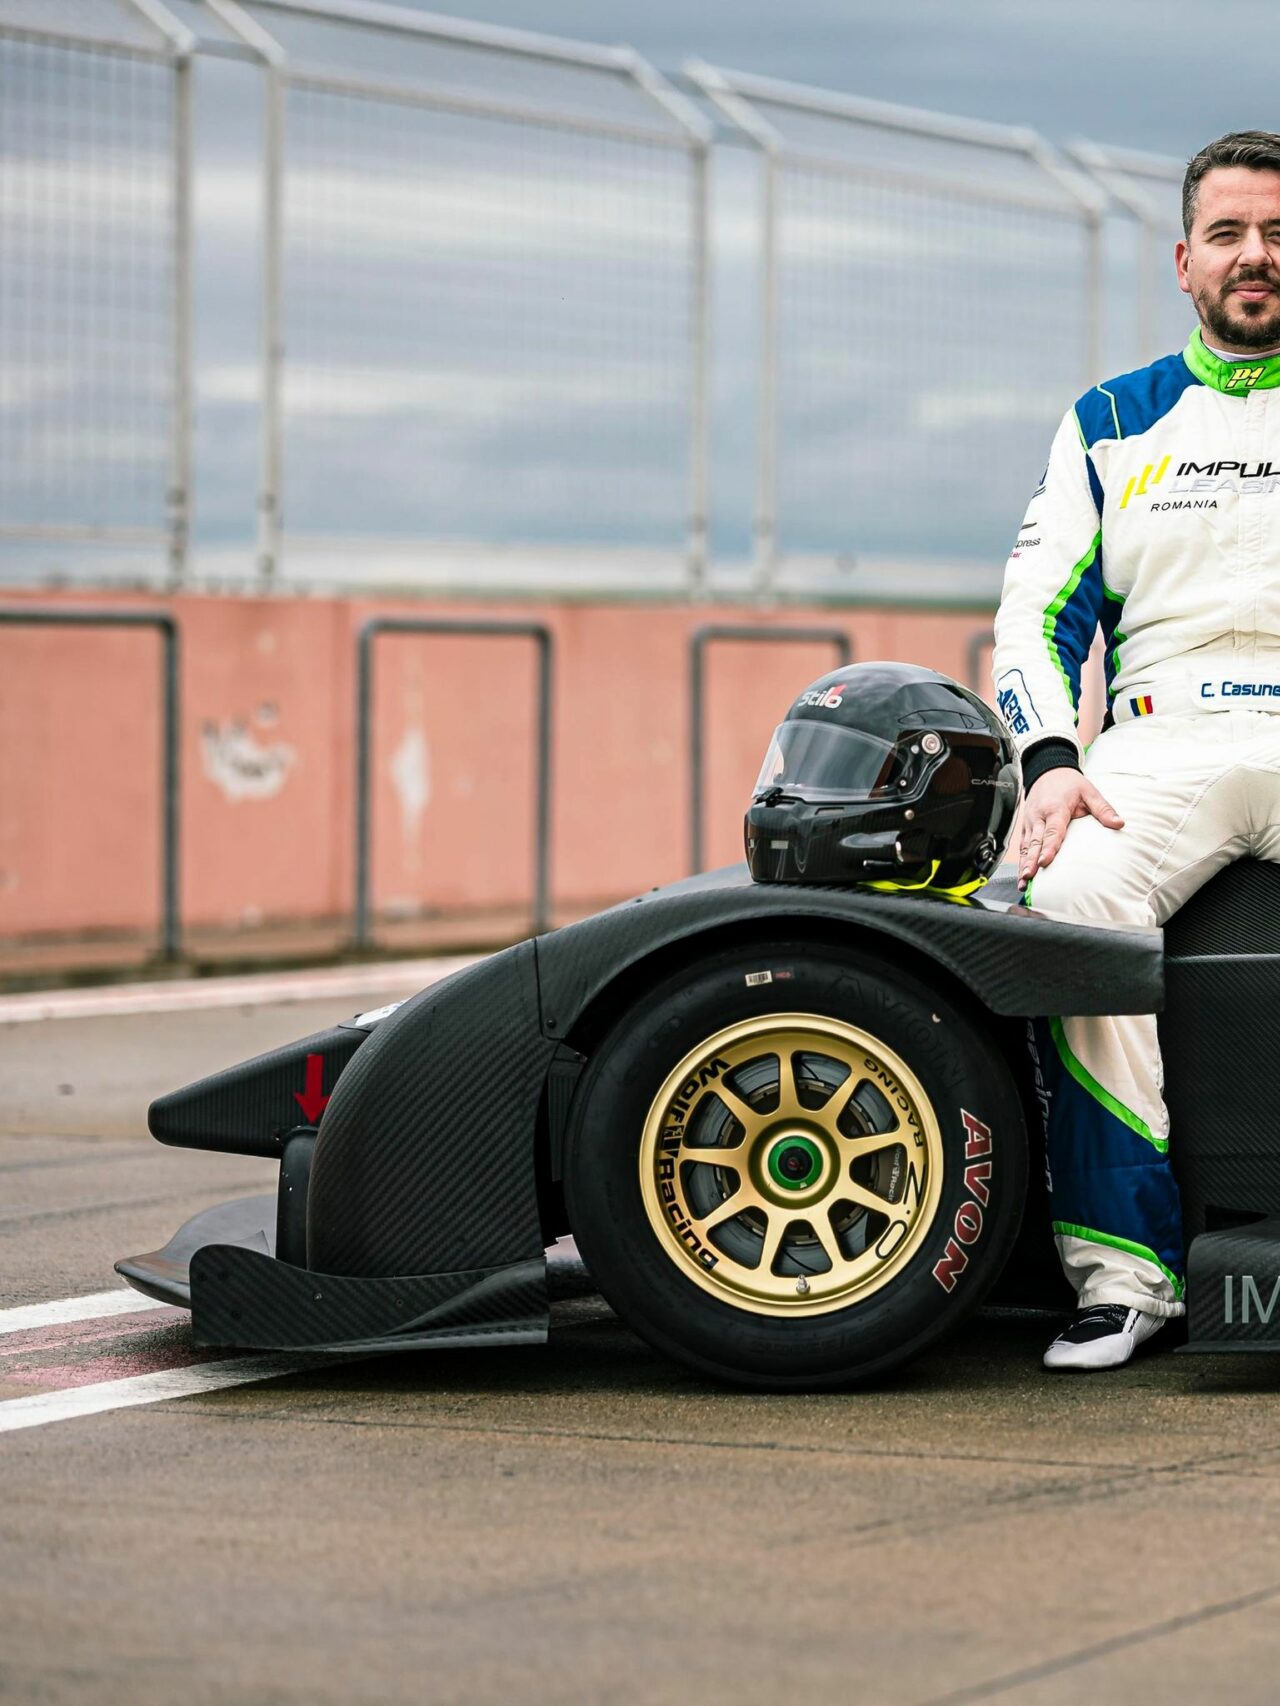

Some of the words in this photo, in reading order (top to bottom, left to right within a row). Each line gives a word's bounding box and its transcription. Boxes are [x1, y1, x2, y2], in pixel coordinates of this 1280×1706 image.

[1150, 500, 1219, 512] ROMANIA
[1201, 683, 1215, 698] C.
[863, 1056, 924, 1148] RACING
[932, 1107, 993, 1295] AVON
